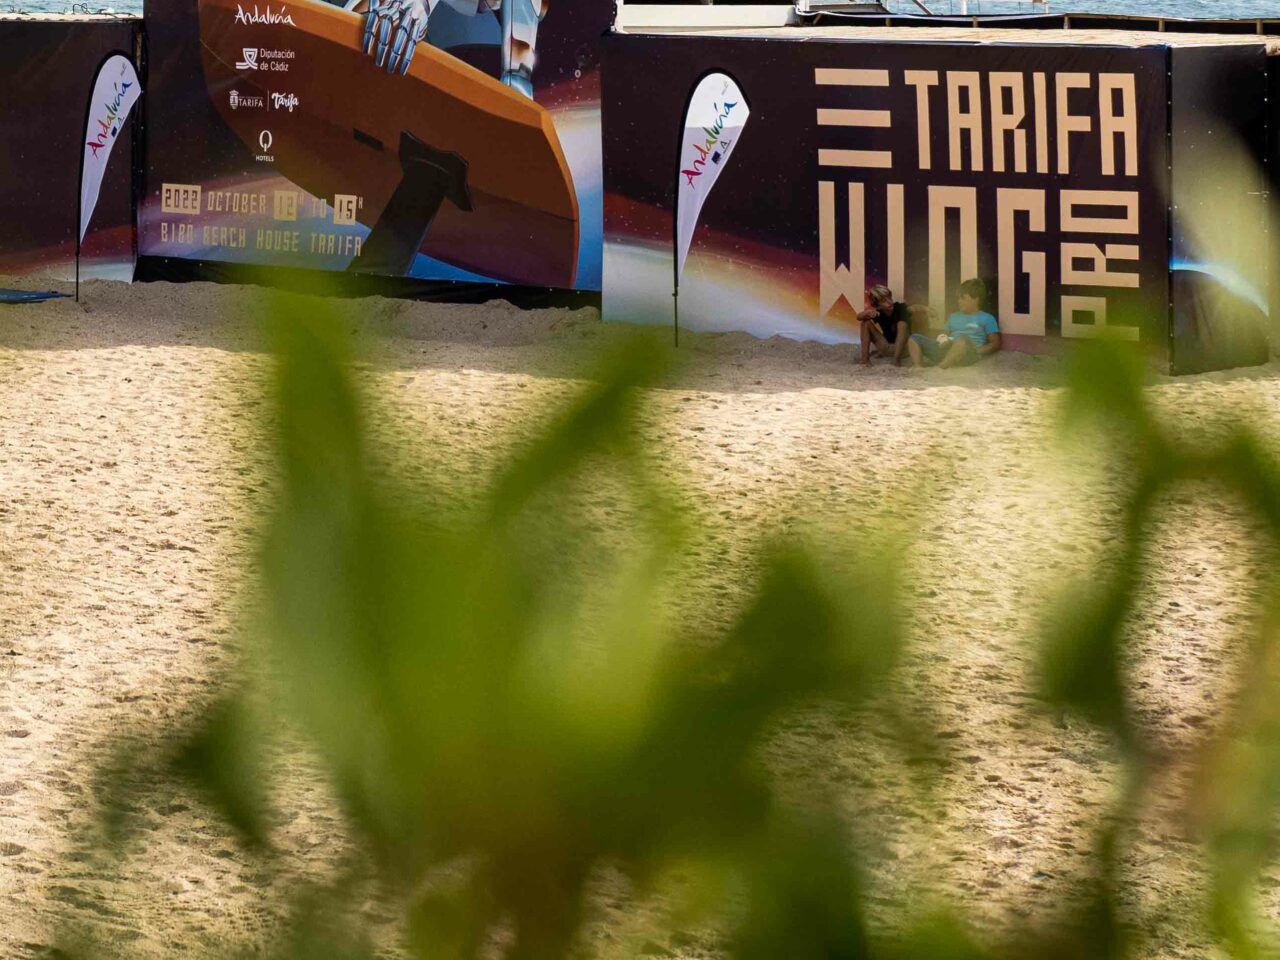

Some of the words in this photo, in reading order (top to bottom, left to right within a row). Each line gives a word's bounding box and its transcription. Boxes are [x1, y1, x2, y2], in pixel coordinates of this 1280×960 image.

[235, 4, 297, 27] Andalucía
[260, 48, 295, 59] Diputación
[260, 61, 269, 71] de
[270, 61, 289, 72] Cádiz
[238, 98, 264, 108] TARIFA
[271, 92, 299, 112] Tarifa
[87, 82, 133, 159] Andalucía
[904, 69, 1139, 176] TARIFA
[259, 130, 272, 152] Q
[681, 102, 738, 191] Andalucía
[164, 188, 198, 210] 2022
[207, 191, 266, 214] OCTOBER
[312, 197, 327, 219] TO
[203, 225, 246, 248] BEACH
[257, 228, 299, 252] HOUSE
[310, 233, 361, 257] TARIFA
[818, 180, 1046, 337] WING
[1060, 189, 1140, 341] PRO
